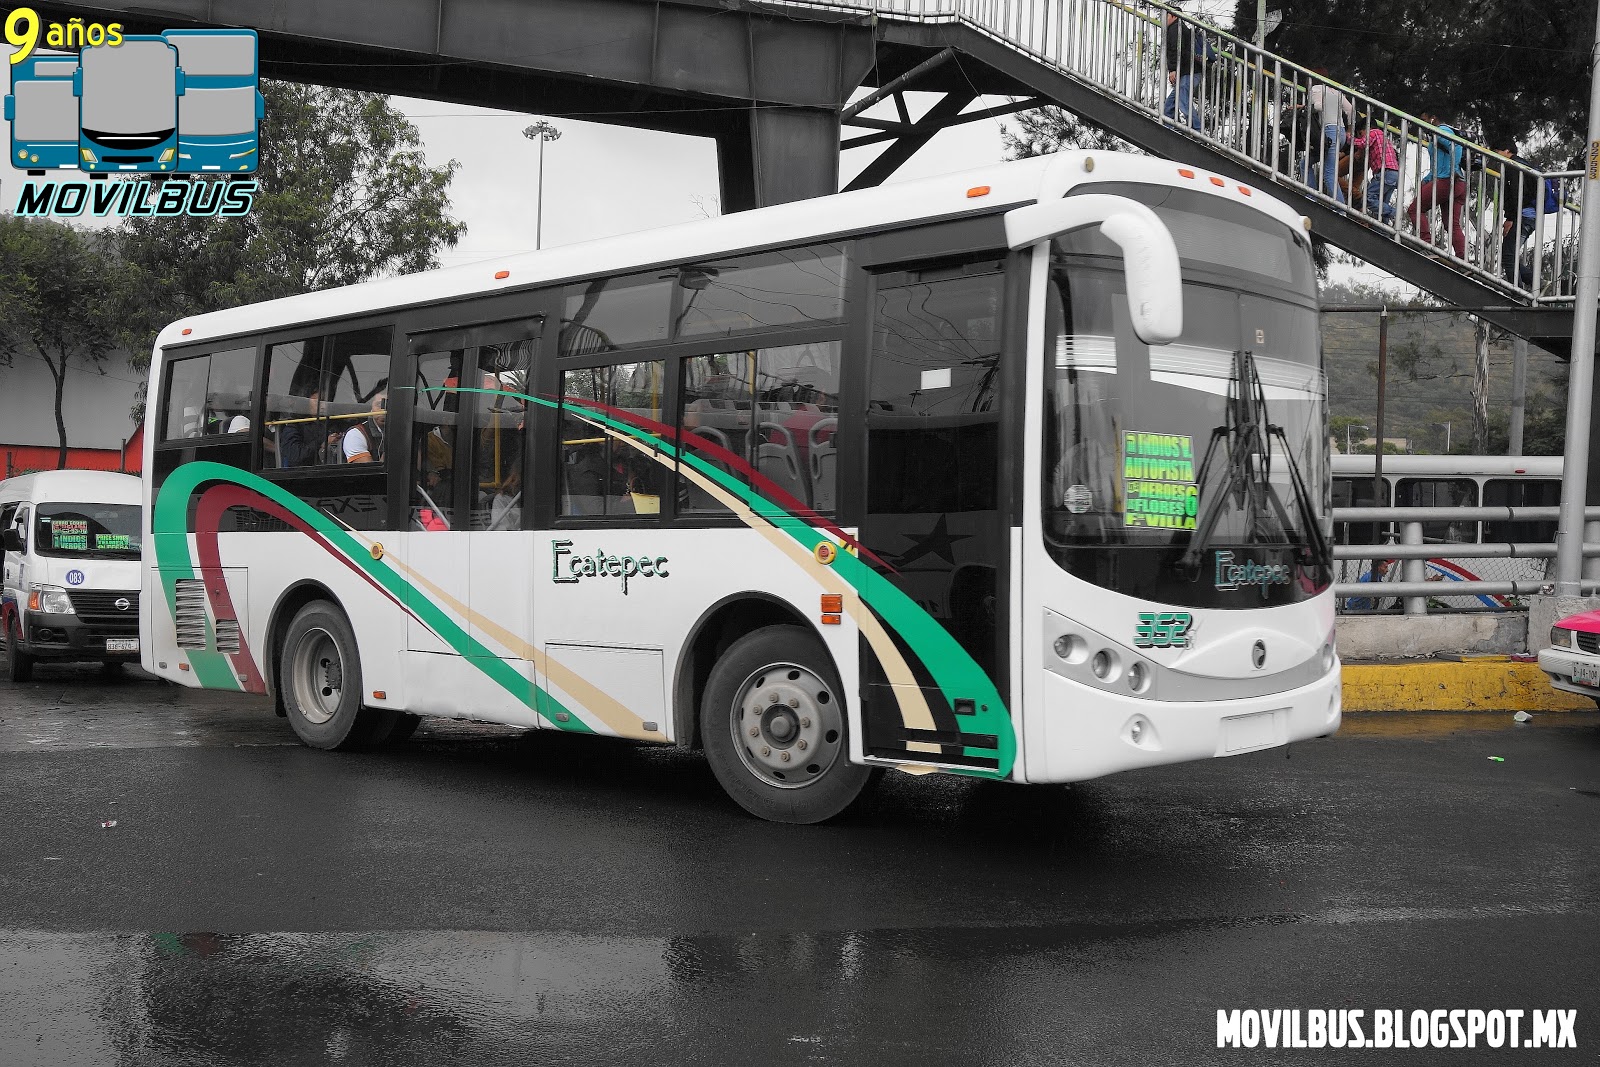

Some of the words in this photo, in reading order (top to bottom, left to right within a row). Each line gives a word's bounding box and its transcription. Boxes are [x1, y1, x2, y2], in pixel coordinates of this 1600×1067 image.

[1124, 457, 1194, 480] AUTOPISTA
[1139, 482, 1185, 501] HEROES
[1146, 514, 1197, 529] VILLA
[60, 542, 86, 550] VERDES
[69, 572, 82, 584] 083
[551, 539, 670, 596] Ecatepec
[1215, 550, 1290, 600] Ecatepec
[1133, 612, 1193, 648] 352
